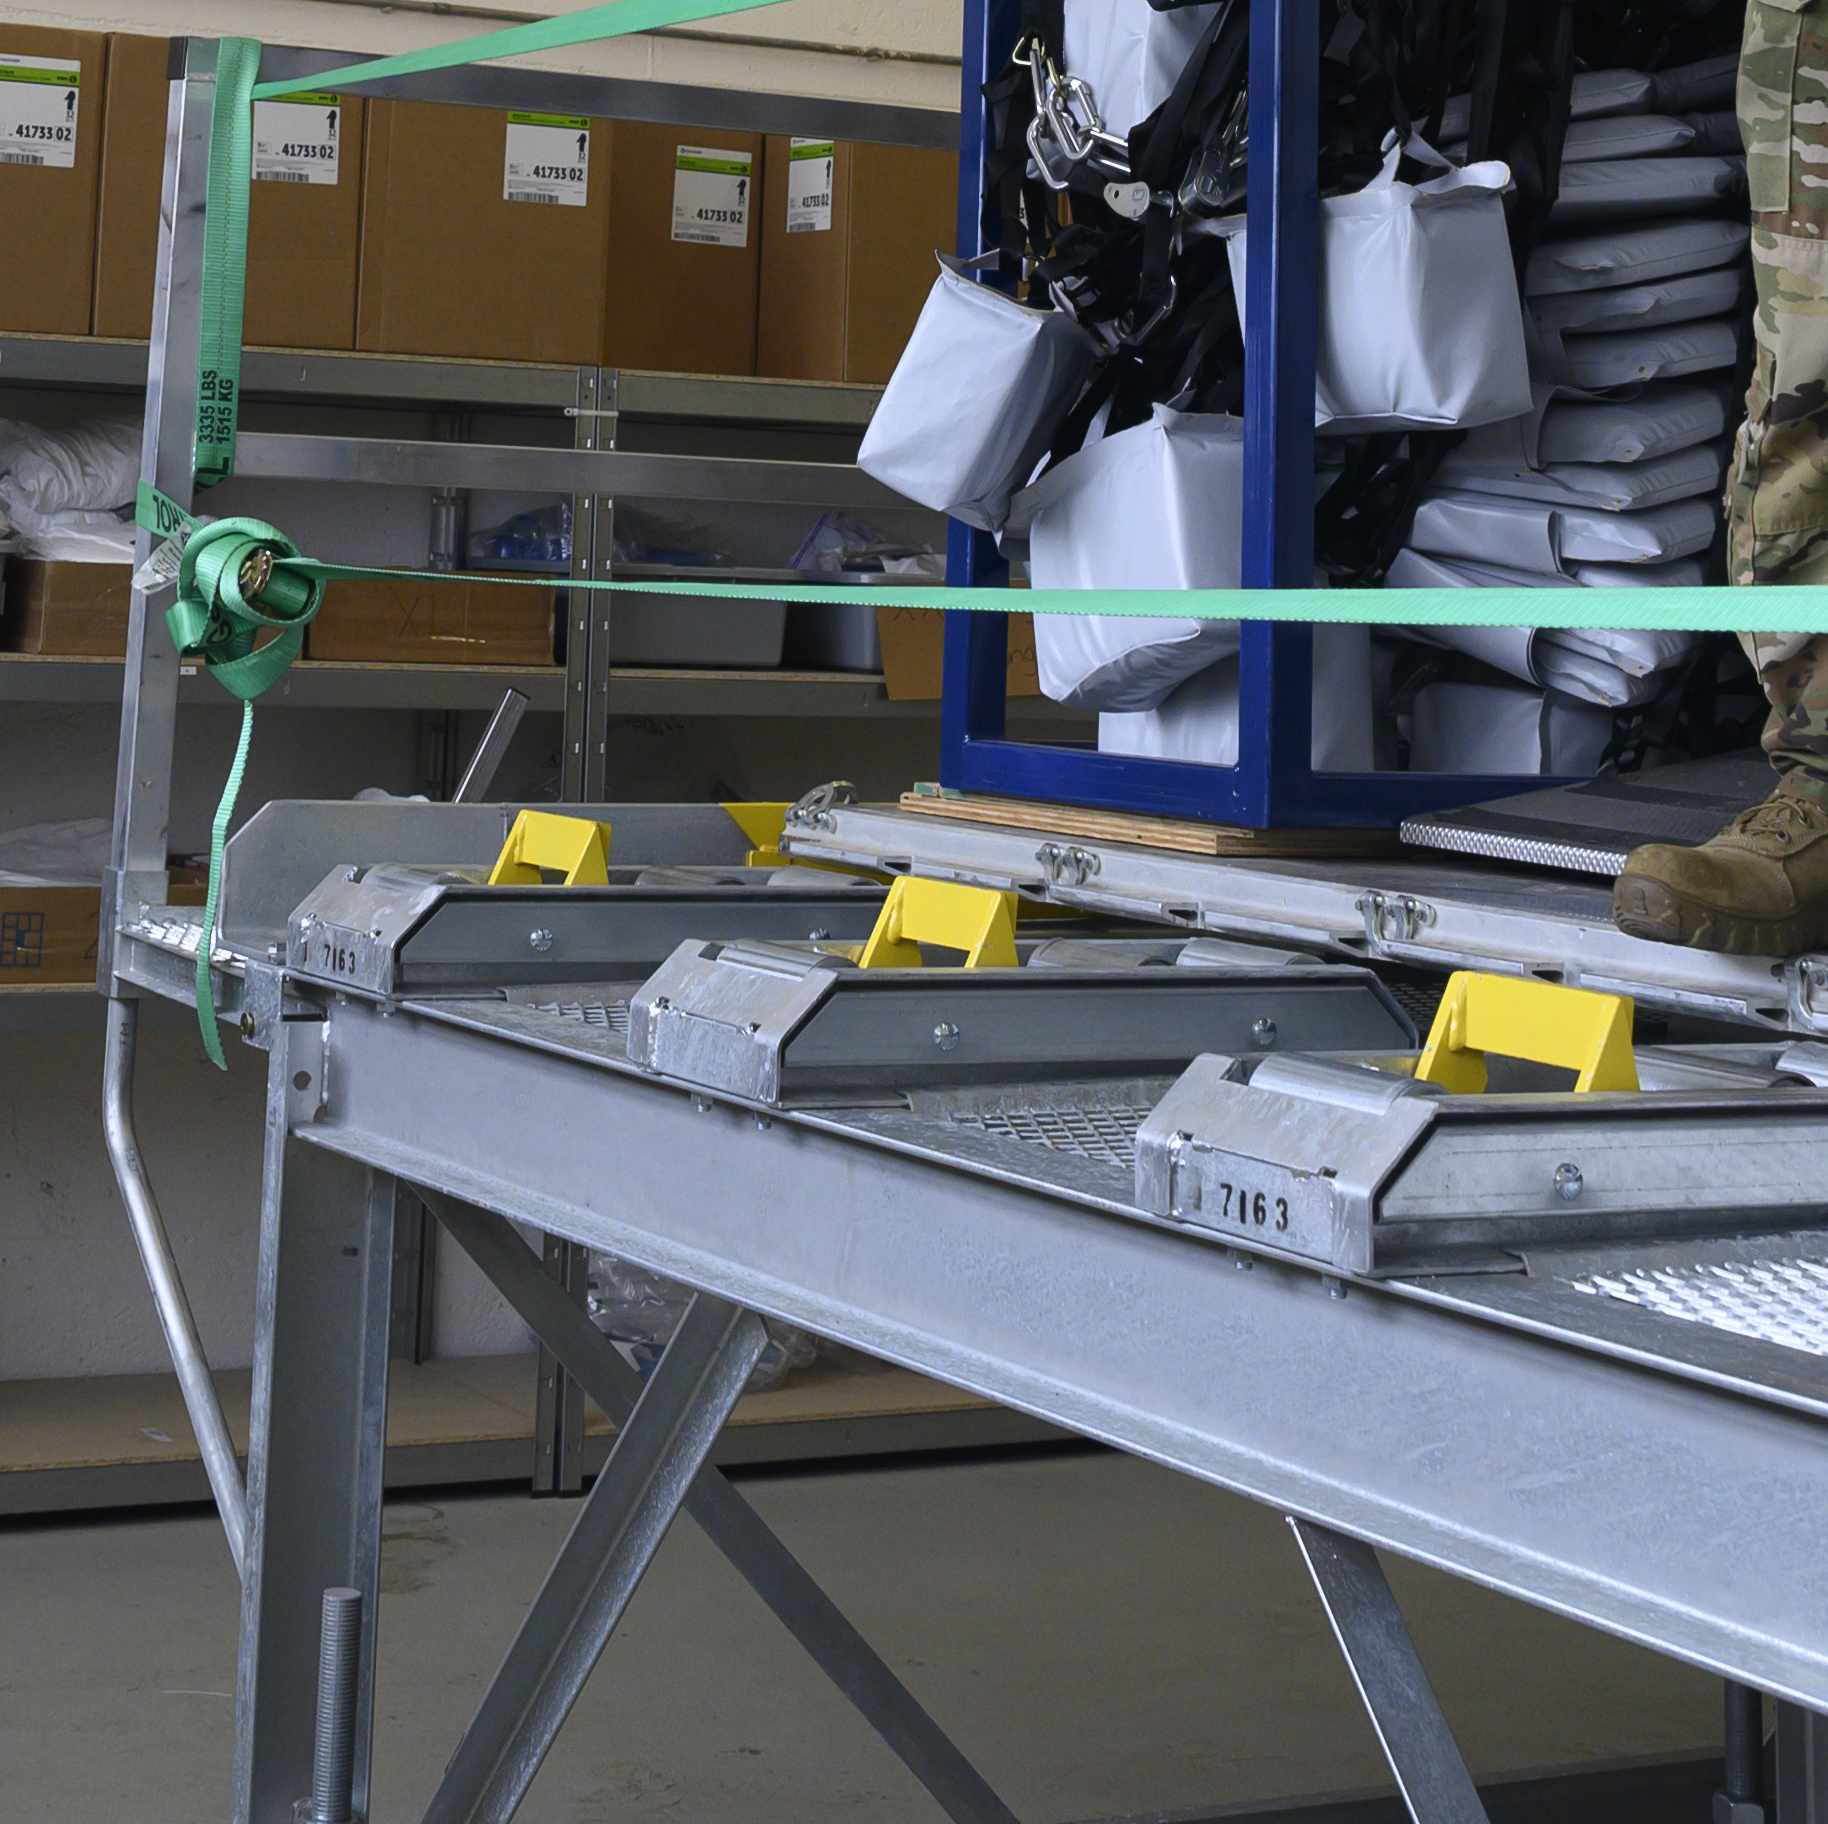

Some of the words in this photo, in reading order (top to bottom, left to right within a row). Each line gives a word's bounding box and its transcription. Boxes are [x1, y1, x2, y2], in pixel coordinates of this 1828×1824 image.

[16, 124, 53, 139] 41733
[56, 127, 71, 141] 02
[282, 143, 317, 158] 41733
[319, 145, 334, 159] 02
[533, 165, 567, 180] 41733
[569, 168, 583, 181] 02
[802, 195, 820, 207] 41733
[821, 194, 829, 206] 02
[696, 208, 728, 222] 41733
[729, 211, 743, 223] 02
[202, 369, 217, 401] LBS
[219, 378, 234, 403] KG
[199, 405, 215, 444] 3335
[216, 406, 231, 443] 1515
[324, 943, 355, 974] 7163
[1220, 1182, 1289, 1233] 7163
